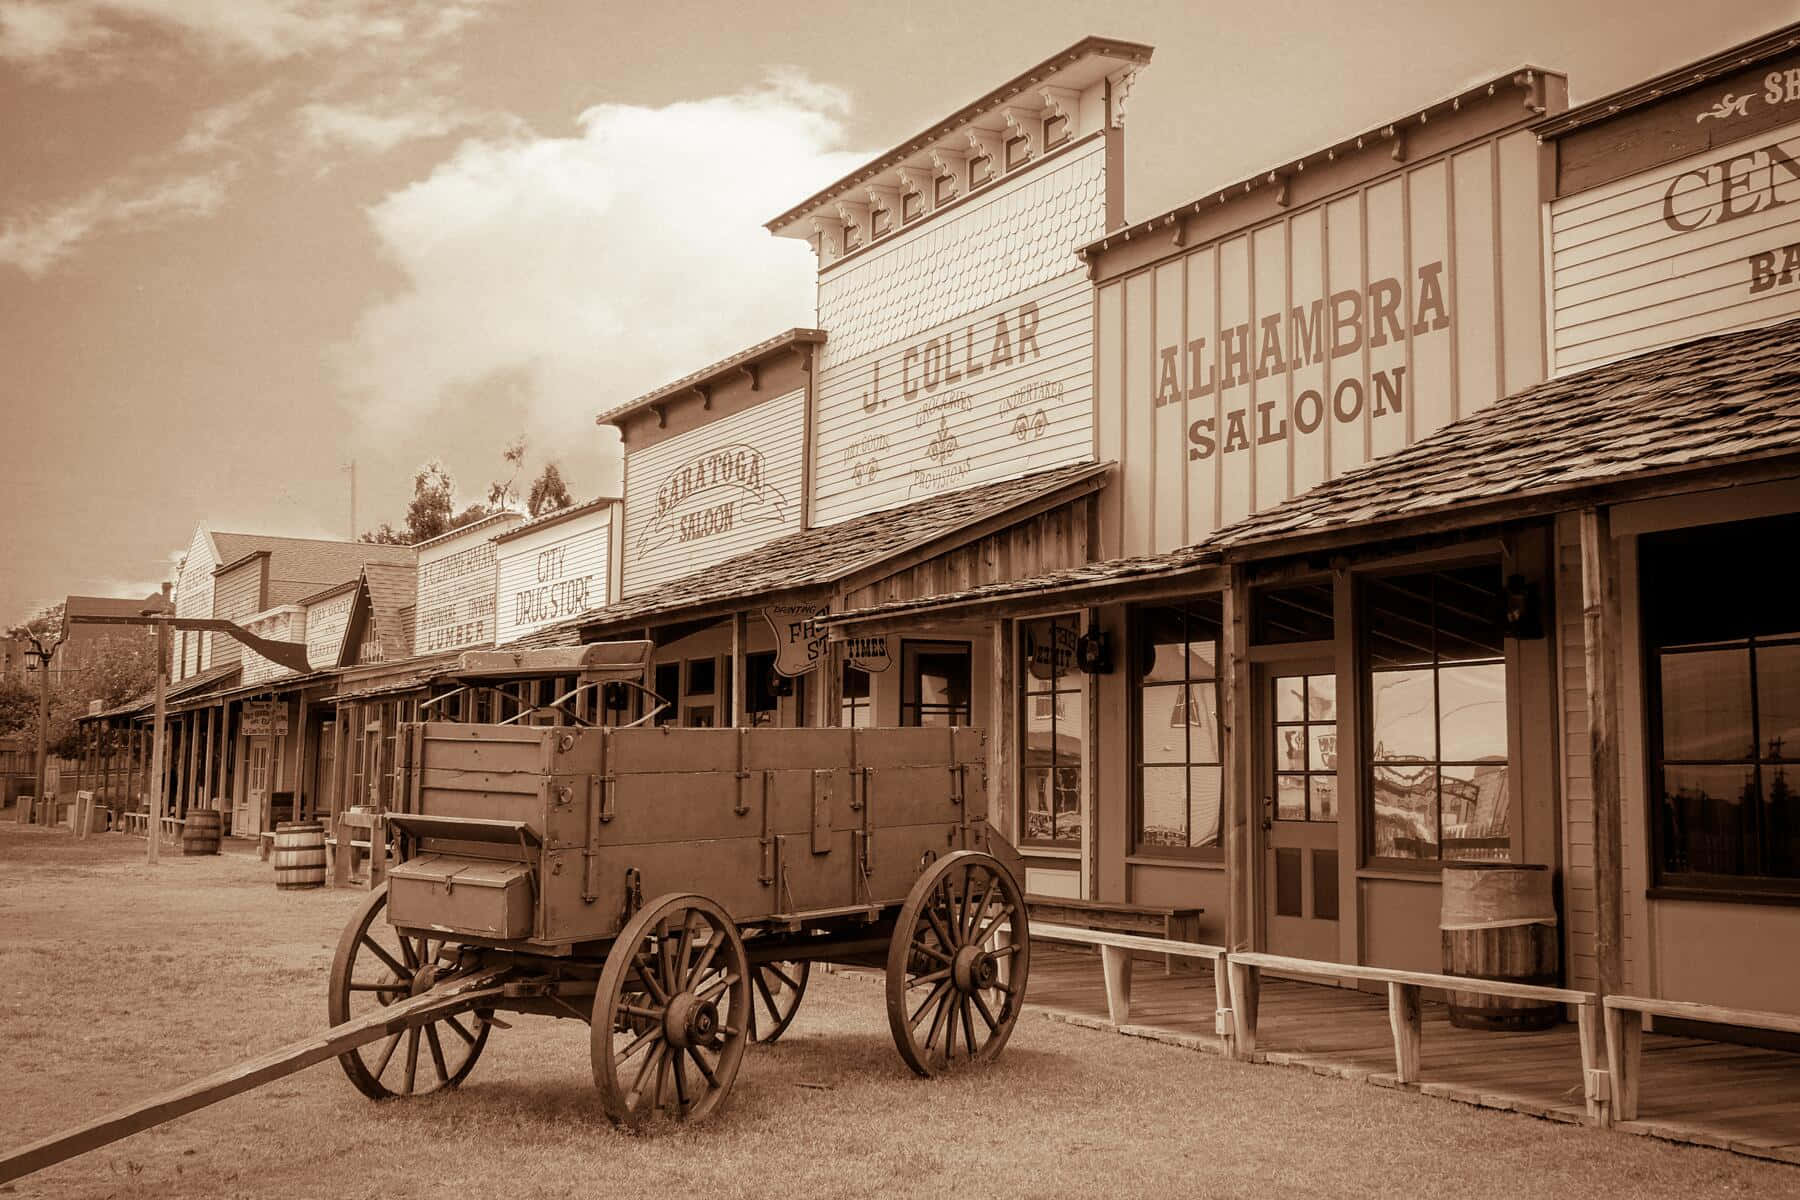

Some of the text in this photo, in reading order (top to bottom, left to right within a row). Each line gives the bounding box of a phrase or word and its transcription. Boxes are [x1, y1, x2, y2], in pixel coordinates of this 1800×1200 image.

[1663, 145, 1800, 232] CEN
[1155, 261, 1449, 408] ALHAMBRA
[863, 301, 1041, 414] J. COLLAR
[914, 391, 973, 428] GROCERIES
[1000, 380, 1065, 419] UNDERTAKER
[1189, 366, 1406, 461] SALOON
[658, 451, 762, 518] SARATOGA
[680, 503, 733, 543] SALOON
[537, 546, 566, 583] CITY
[515, 575, 593, 626] DRUG STORE
[427, 620, 484, 651] LUMBER
[847, 637, 886, 659] TIMES
